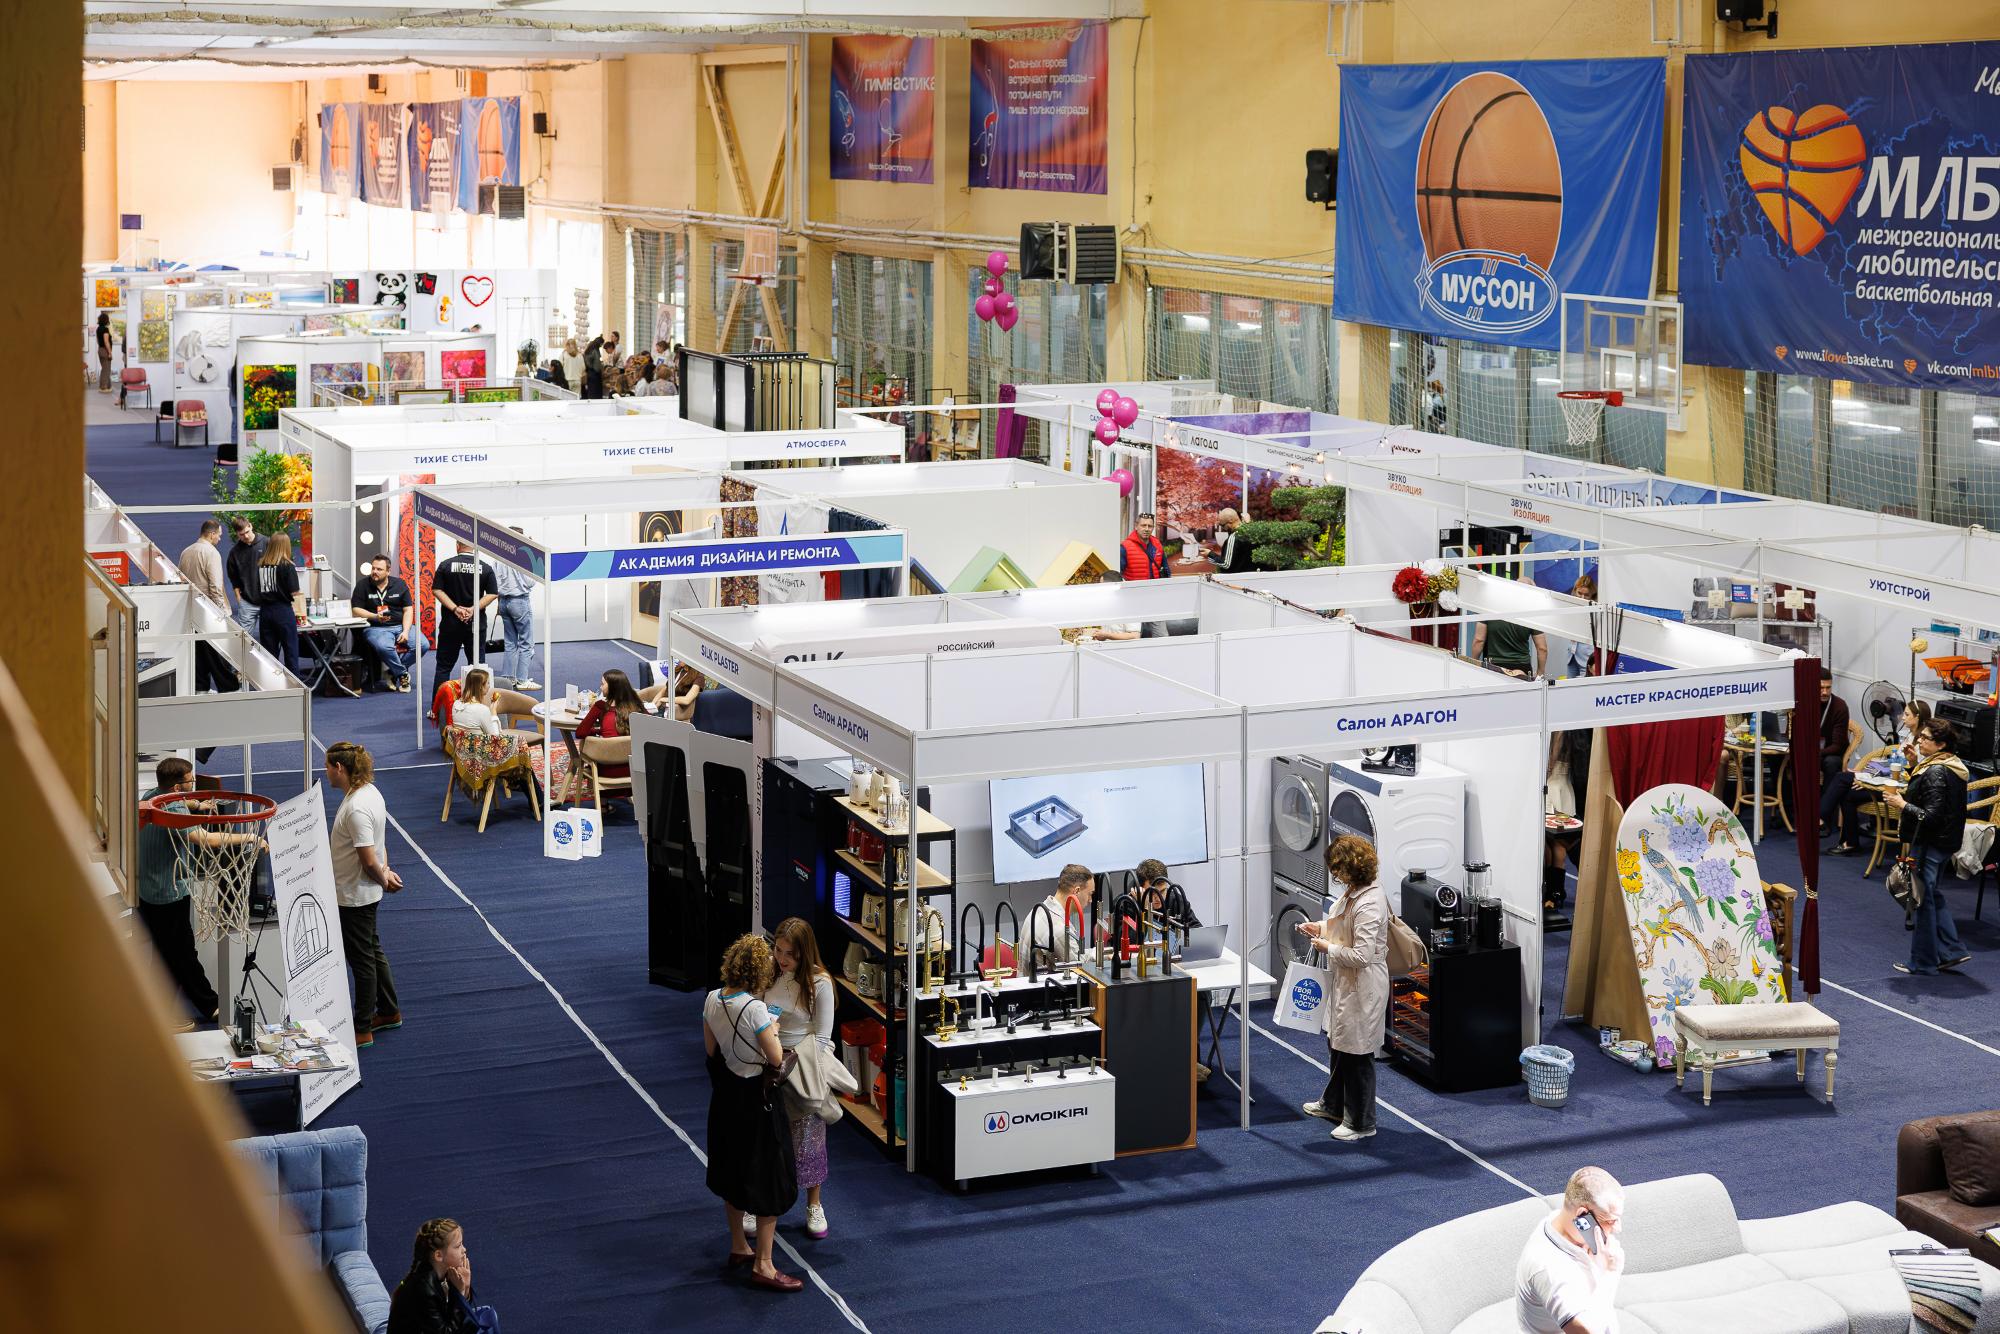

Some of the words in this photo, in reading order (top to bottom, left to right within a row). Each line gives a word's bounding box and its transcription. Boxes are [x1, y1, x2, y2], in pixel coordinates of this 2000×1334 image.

[1008, 91, 1032, 99] потом
[1032, 90, 1043, 99] на
[1043, 90, 1062, 101] пути
[1856, 249, 2000, 280] любительс
[1441, 273, 1536, 312] МУССОН
[1856, 280, 1993, 307] баскетбольная
[1795, 349, 1894, 369] www.ilovebasket.ru
[603, 448, 636, 456] ТИХИЕ
[638, 446, 673, 455] СТЕНЫ
[786, 439, 847, 449] АТМОСФЕРА
[414, 455, 448, 464] ТИХИЕ
[451, 454, 488, 463] СТЕНЫ
[1387, 472, 1407, 484] ЗВУКО
[1389, 482, 1424, 496] ИЗОЛЯЦИЯ
[1510, 498, 1533, 511] ЗВУКО
[1513, 508, 1550, 524] ИЗОЛЯЦИЯ
[618, 555, 695, 570] АКАДЕМИЯ
[700, 550, 766, 567] ДИЗАЙНА
[768, 549, 777, 561] И
[780, 546, 841, 560] РЕМОНТА
[1869, 578, 1931, 601] УЮТСТРОЙ
[937, 641, 995, 652] РОССИЙСКИЙ
[701, 644, 714, 661] SILK
[714, 652, 739, 675] PLASTER
[1595, 693, 1646, 707] МАСТЕР
[1649, 681, 1768, 702] КРАСНОДЕРЕВЩИК
[813, 703, 836, 725] Салон
[836, 715, 869, 743] АРАГОН
[1336, 717, 1386, 731] Салон
[1391, 709, 1457, 727] АРАГОН
[1294, 986, 1312, 995] ТВОЯ
[1299, 994, 1322, 1003] ТОЧКА
[1294, 999, 1315, 1009] РОСТА
[1011, 1107, 1088, 1125] OMOIKIRI
